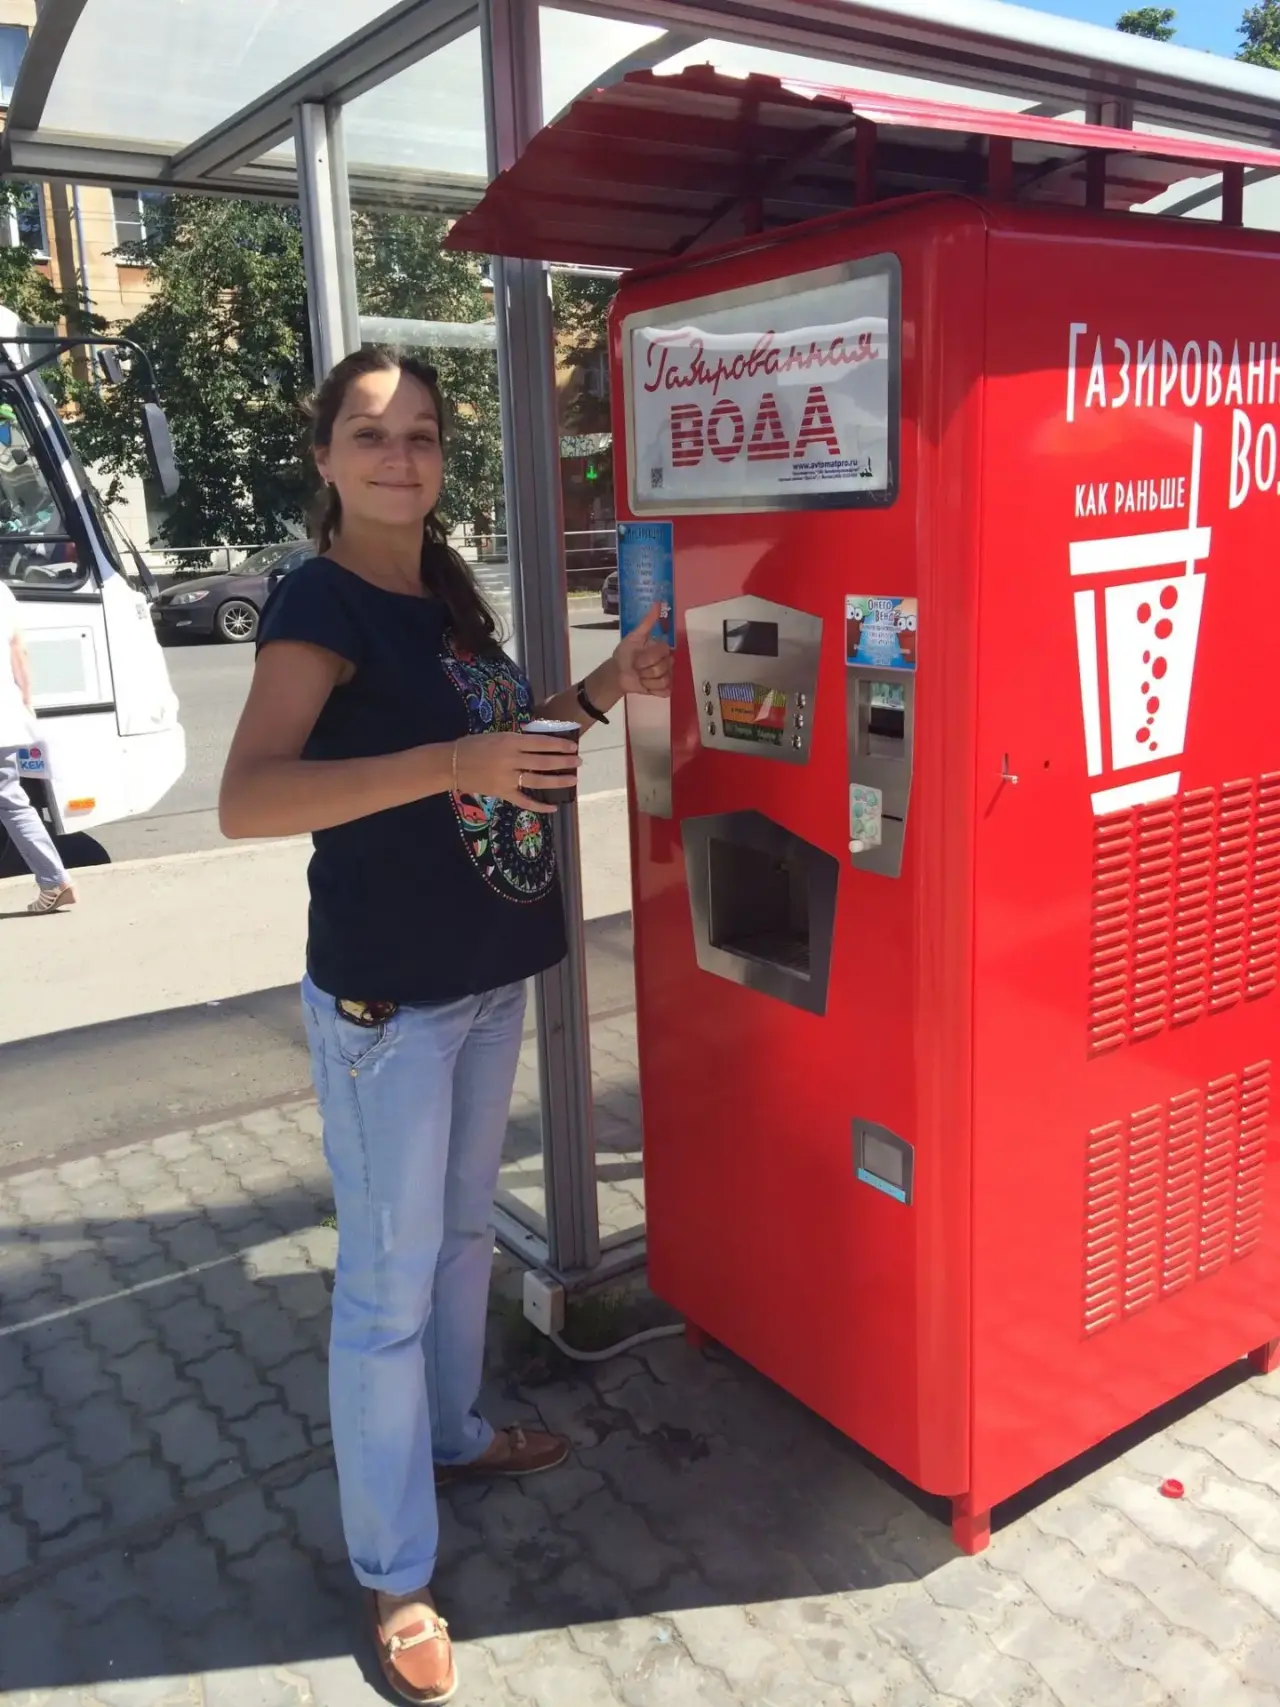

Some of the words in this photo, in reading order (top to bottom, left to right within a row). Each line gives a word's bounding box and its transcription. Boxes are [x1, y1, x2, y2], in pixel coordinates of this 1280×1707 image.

[644, 330, 880, 396] Газированная
[670, 385, 841, 468] ВОДА
[1229, 408, 1280, 510] ВО
[792, 459, 858, 470] www.avtomatpro.ru
[1075, 482, 1109, 518] КАК
[1114, 476, 1186, 514] РАНЬШЕ
